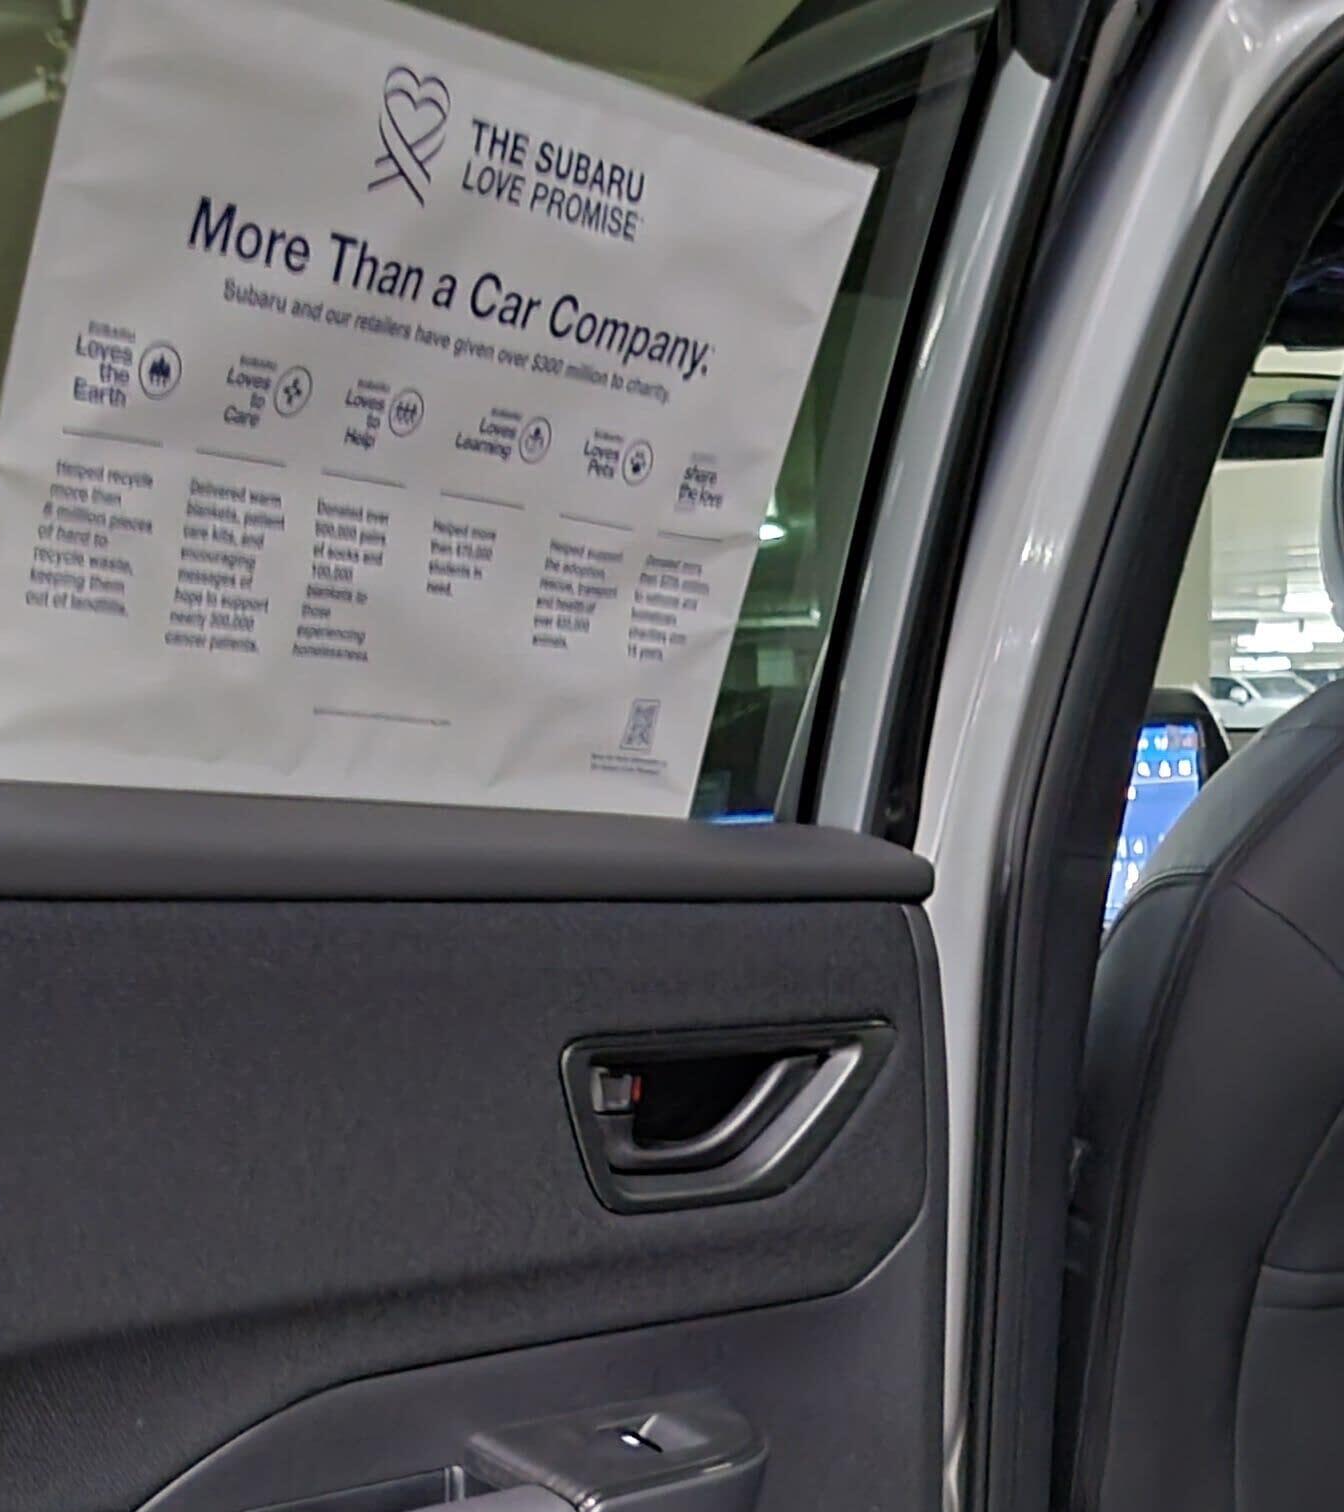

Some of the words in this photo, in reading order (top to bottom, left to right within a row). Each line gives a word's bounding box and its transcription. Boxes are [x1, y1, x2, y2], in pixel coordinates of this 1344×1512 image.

[471, 118, 528, 167] THE
[535, 141, 645, 203] SUBARU
[462, 159, 521, 207] LOVE
[530, 184, 639, 242] PROMISE
[188, 196, 311, 272] More
[330, 233, 422, 302] Than
[431, 276, 457, 309] a
[470, 272, 541, 330] Car
[223, 279, 288, 313] Subaru
[291, 296, 322, 322] and
[325, 306, 353, 328] our
[355, 312, 412, 344] retailers
[415, 325, 451, 351] have
[454, 335, 494, 364] given
[497, 344, 528, 370] over
[531, 353, 562, 376] $300
[565, 360, 607, 388] million
[610, 371, 623, 391] to
[76, 335, 132, 366] Loves
[100, 362, 130, 383] the
[227, 367, 271, 390] Loves
[74, 375, 126, 408] Earth
[250, 391, 266, 409] to
[345, 388, 385, 412] Loves
[224, 405, 260, 428] Care
[366, 413, 380, 429] to
[479, 417, 517, 439] Loves
[344, 426, 376, 451] Help
[455, 432, 512, 461] Learning
[583, 439, 620, 463] Loves
[587, 459, 614, 480] Pets
[683, 464, 718, 485] share
[50, 483, 88, 502] more
[57, 525, 89, 545] hard
[94, 533, 108, 548] to
